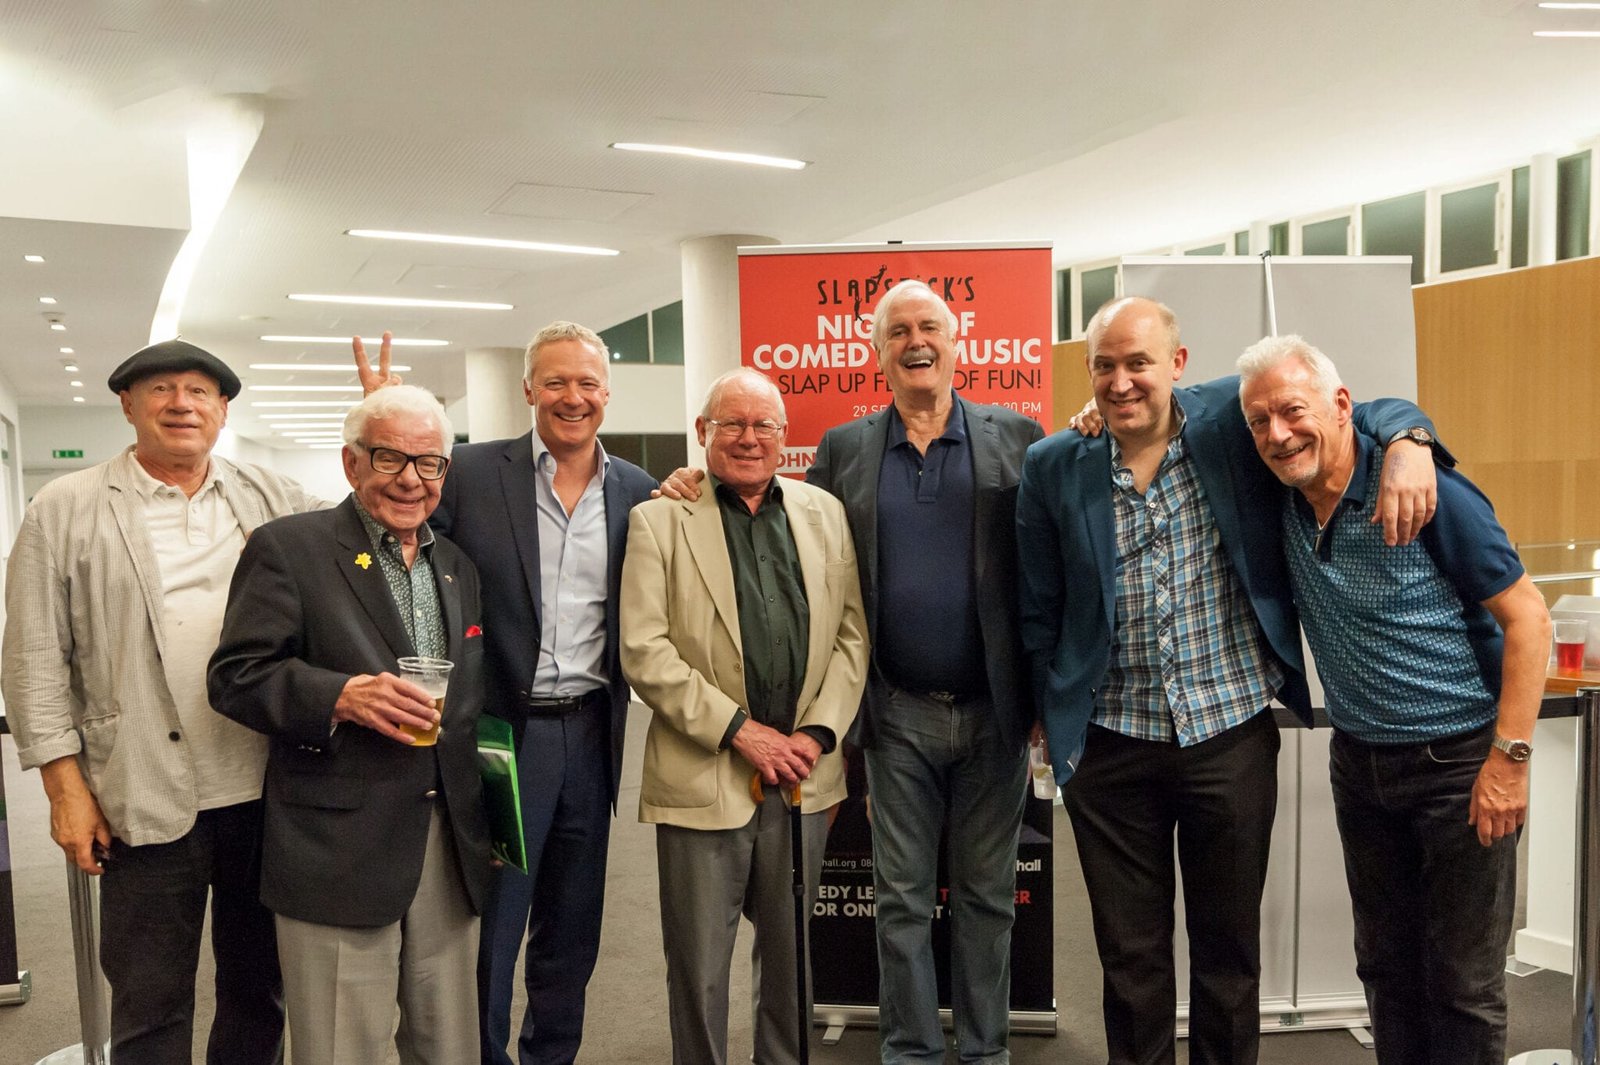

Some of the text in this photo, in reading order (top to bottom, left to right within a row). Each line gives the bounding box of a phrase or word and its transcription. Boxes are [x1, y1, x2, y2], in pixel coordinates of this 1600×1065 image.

[817, 313, 874, 341] NIG
[753, 342, 880, 370] COMED
[778, 373, 830, 395] SLAP
[838, 373, 866, 393] UP
[954, 370, 979, 391] OF
[988, 369, 1041, 390] FUN!
[853, 405, 867, 418] 29
[1022, 401, 1041, 413] PM
[776, 452, 817, 468] OHN
[813, 902, 838, 917] OR
